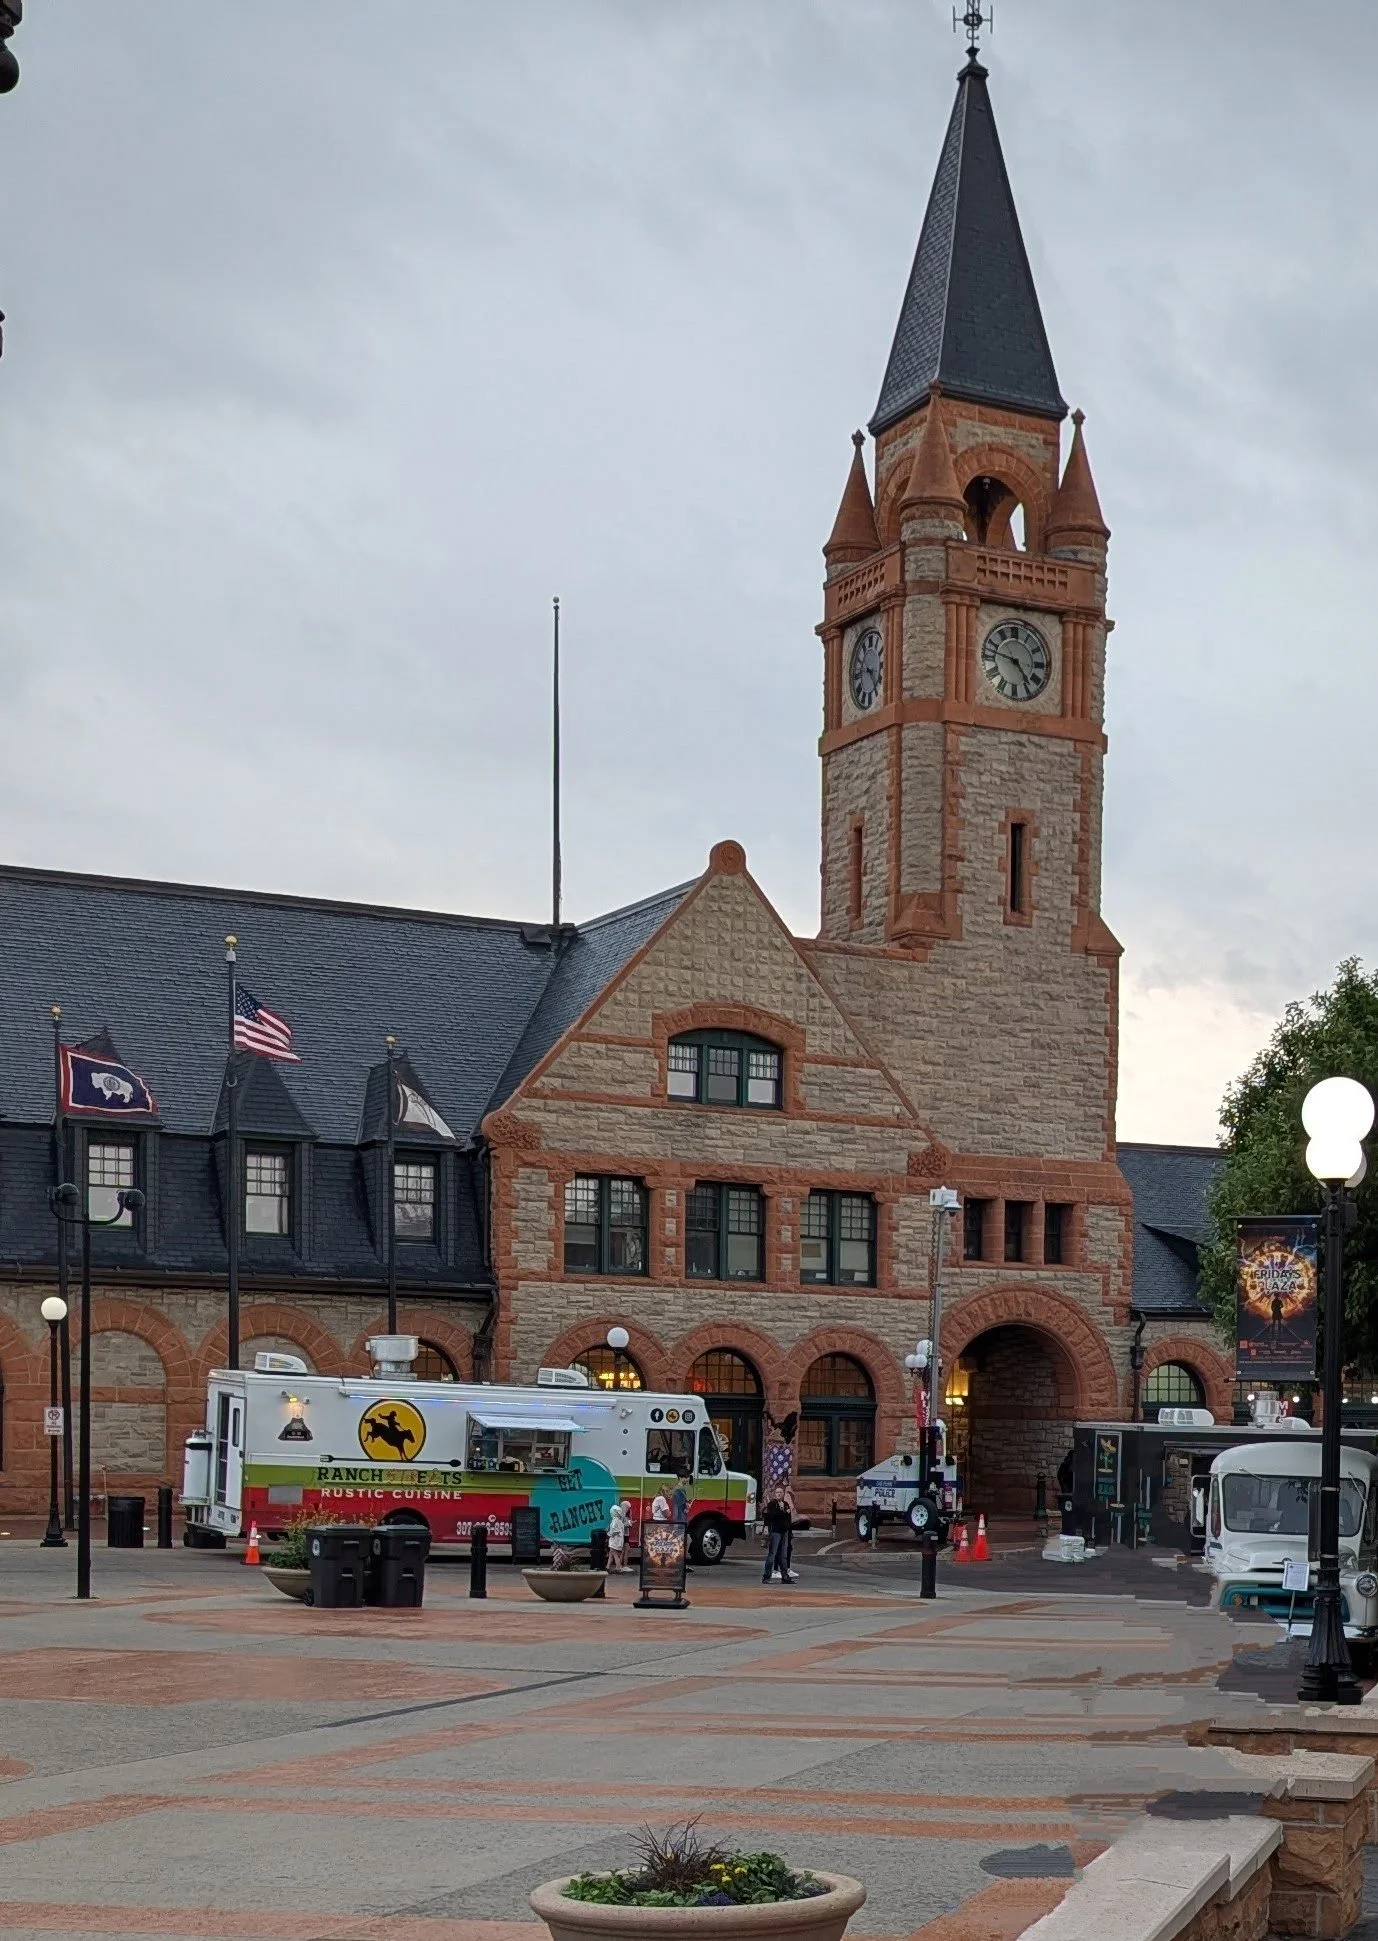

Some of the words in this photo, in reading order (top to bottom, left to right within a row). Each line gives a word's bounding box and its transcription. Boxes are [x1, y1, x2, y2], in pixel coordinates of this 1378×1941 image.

[317, 1466, 384, 1482] RANCH
[320, 1487, 384, 1499] RUSTIC
[392, 1490, 462, 1500] CUISINE
[549, 1498, 604, 1534] RANCHY
